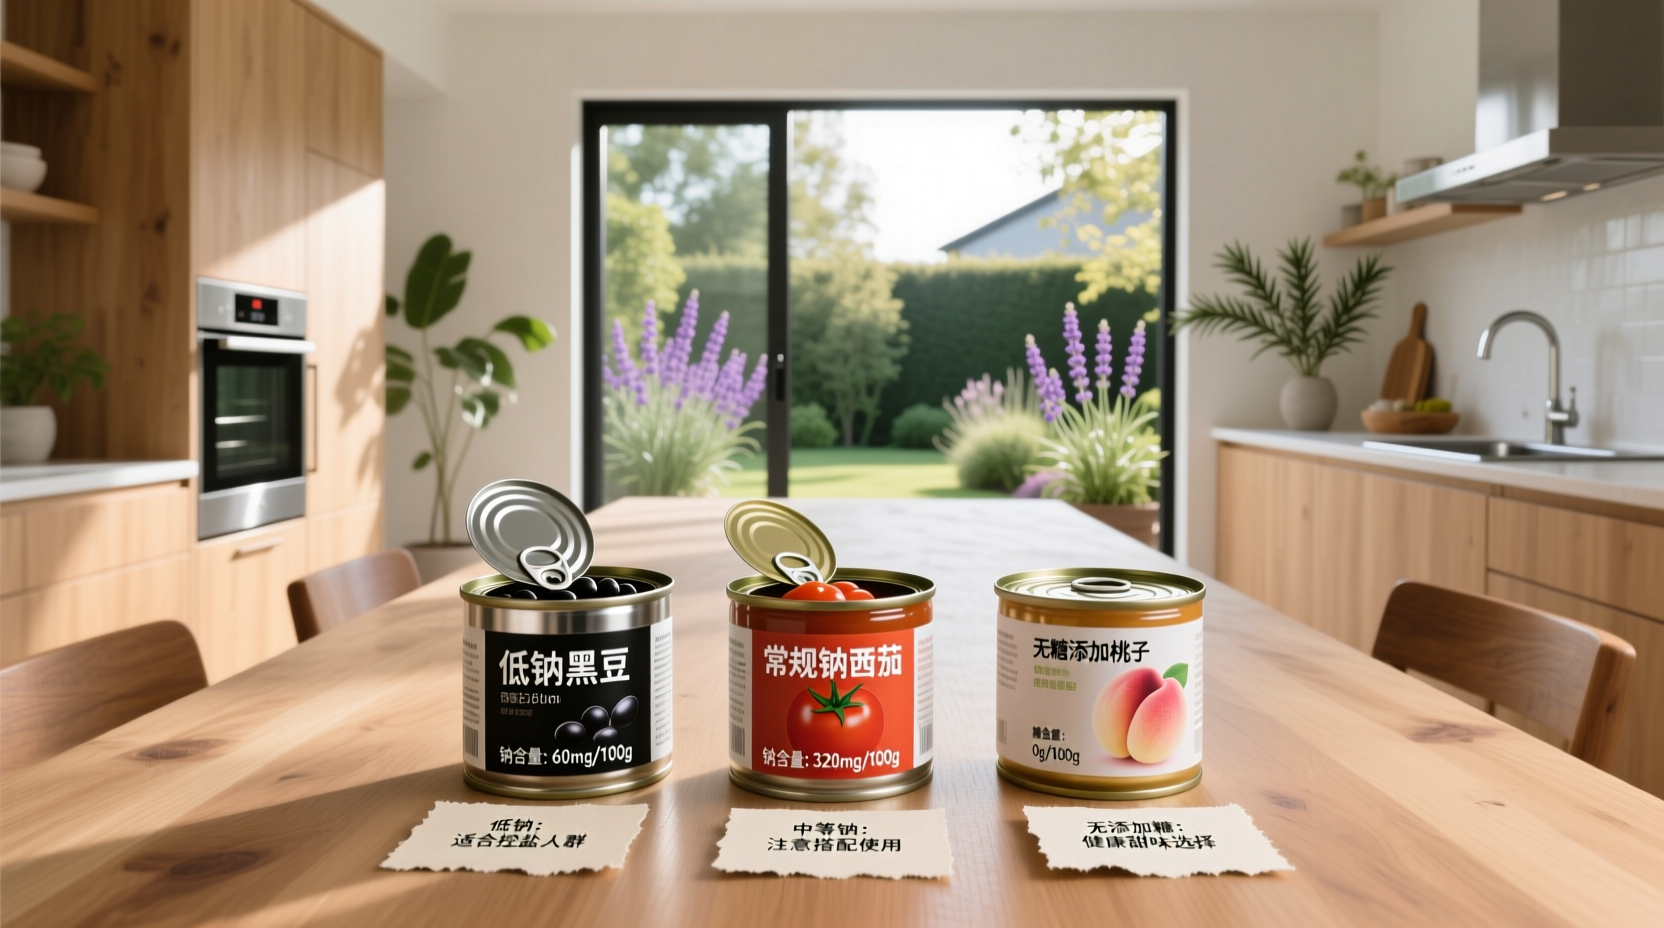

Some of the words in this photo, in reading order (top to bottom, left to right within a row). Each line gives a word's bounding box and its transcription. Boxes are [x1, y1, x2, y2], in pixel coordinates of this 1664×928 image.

[764, 644, 903, 679] 常规钠西茄
[1033, 637, 1150, 664] 无糖添加桃子
[499, 647, 630, 687] 低钠黑豆
[552, 744, 633, 768] 60mg/100g
[812, 749, 900, 773] 320mg/100g
[1032, 743, 1080, 766] 0g/100g
